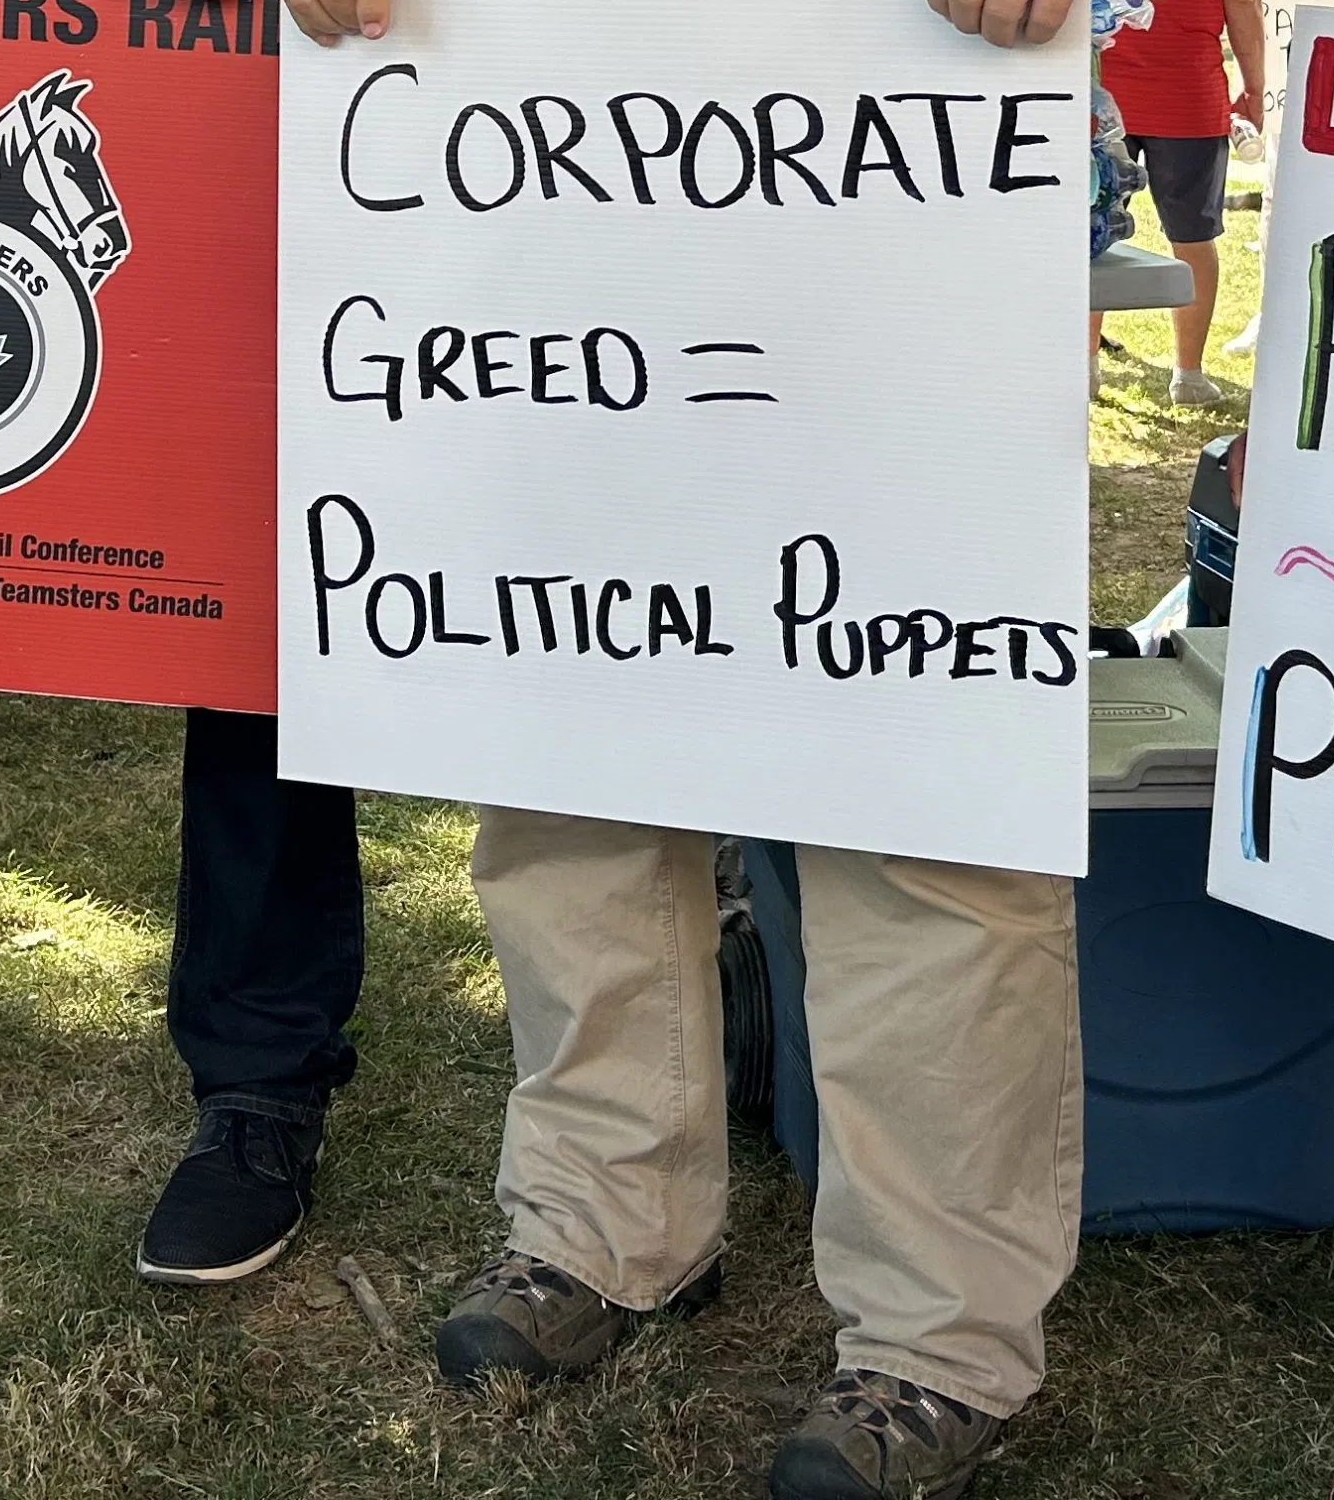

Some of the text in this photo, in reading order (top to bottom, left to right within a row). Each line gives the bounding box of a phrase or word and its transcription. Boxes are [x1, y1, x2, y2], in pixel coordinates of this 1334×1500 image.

[340, 63, 1074, 212] CORPORATE
[323, 294, 649, 421] GREED
[20, 533, 165, 569] Conference
[127, 591, 224, 621] Canada
[306, 493, 1079, 687] POLITICAL PUPPETS
